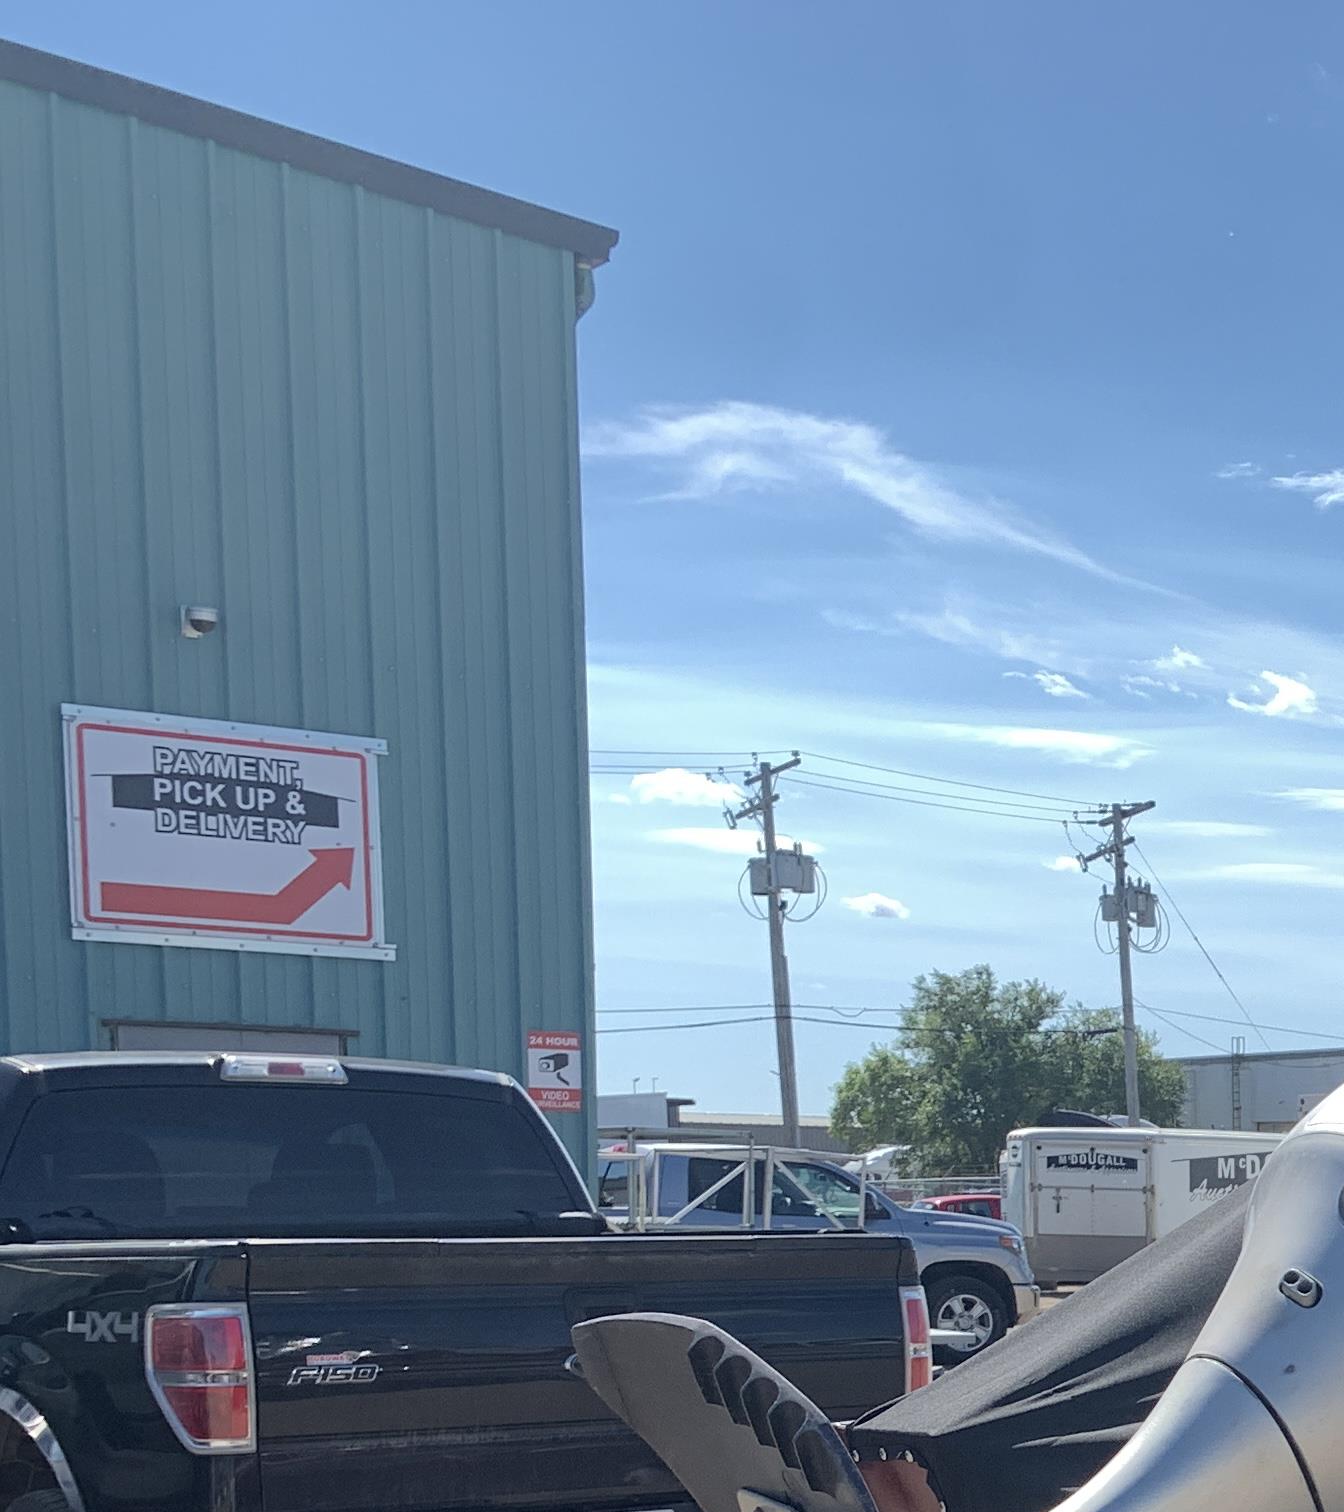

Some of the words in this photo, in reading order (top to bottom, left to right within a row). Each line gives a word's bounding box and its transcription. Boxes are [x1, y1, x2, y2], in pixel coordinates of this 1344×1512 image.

[153, 746, 304, 790] PAYMENT,
[153, 777, 227, 808] PICK
[235, 784, 276, 811] UP
[286, 790, 306, 815] &
[155, 807, 306, 845] DELIVERY
[529, 1036, 543, 1046] 24
[545, 1036, 579, 1047] HOUR
[541, 1090, 570, 1101] VIDEO
